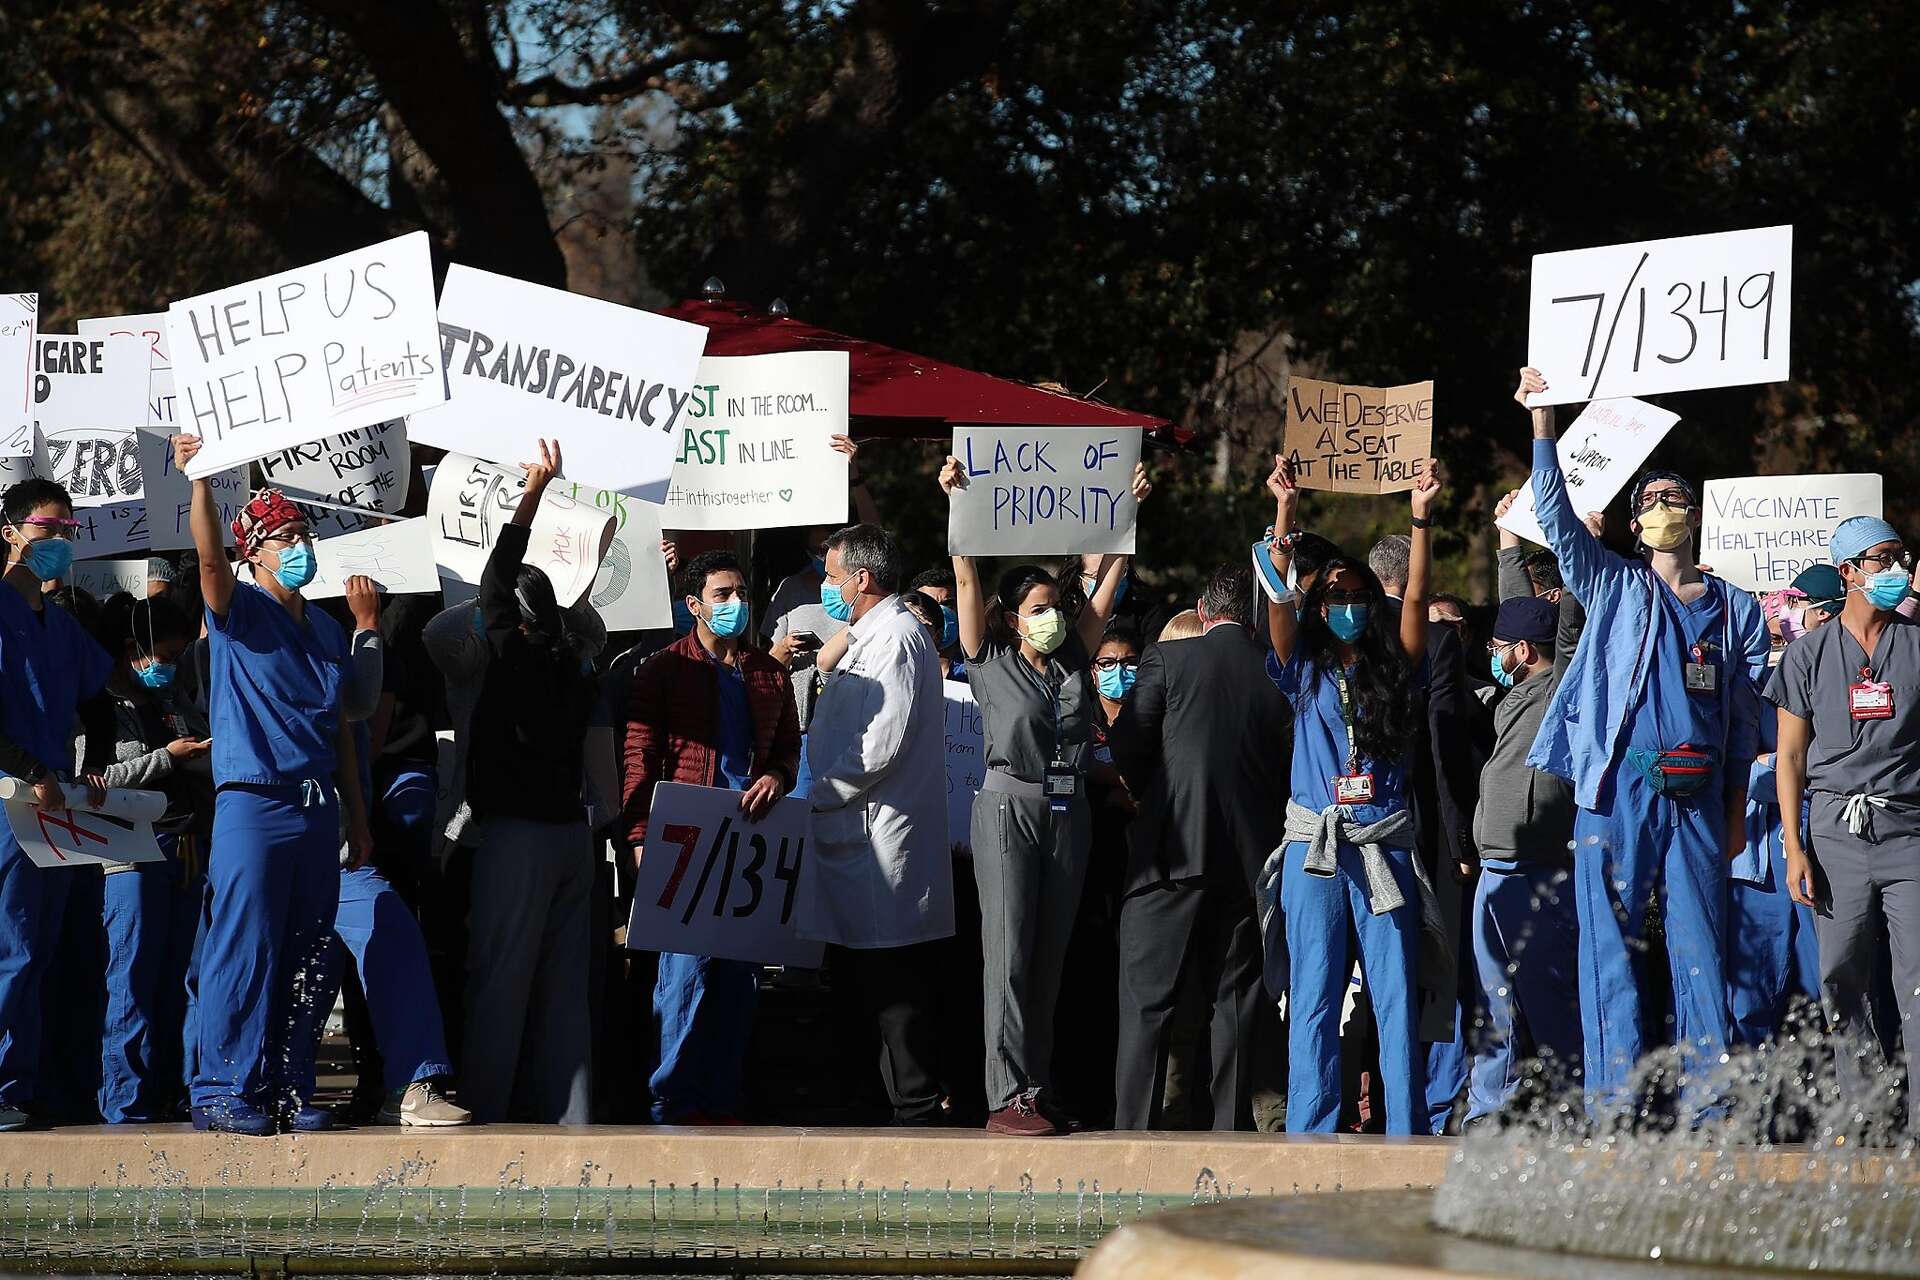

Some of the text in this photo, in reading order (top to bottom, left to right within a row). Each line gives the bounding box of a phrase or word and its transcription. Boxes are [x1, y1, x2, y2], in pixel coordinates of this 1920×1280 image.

[188, 262, 397, 363] HELP US
[1551, 252, 1775, 399] 7/1349
[187, 340, 435, 444] HELP Patients
[438, 321, 690, 434] TRANSPARENCY
[687, 384, 720, 419] ST
[727, 397, 745, 418] IN
[750, 394, 774, 416] THE
[1292, 387, 1433, 427] WE DESERVE
[328, 440, 390, 479] ROOM
[675, 428, 731, 466] AST
[738, 442, 756, 464] IN
[966, 436, 1119, 477] LACK OF
[1315, 427, 1401, 455] A SEAT
[46, 437, 144, 498] ZERO
[1289, 449, 1424, 482] AT THE TABLE
[338, 482, 365, 506] OF
[364, 470, 396, 494] THE
[441, 463, 491, 548] FIRST
[668, 485, 774, 510] #inthistogether
[1710, 486, 1840, 519] VACCINATE
[994, 485, 1126, 531] PRIORITY
[1707, 525, 1829, 551] HEALTHCARE
